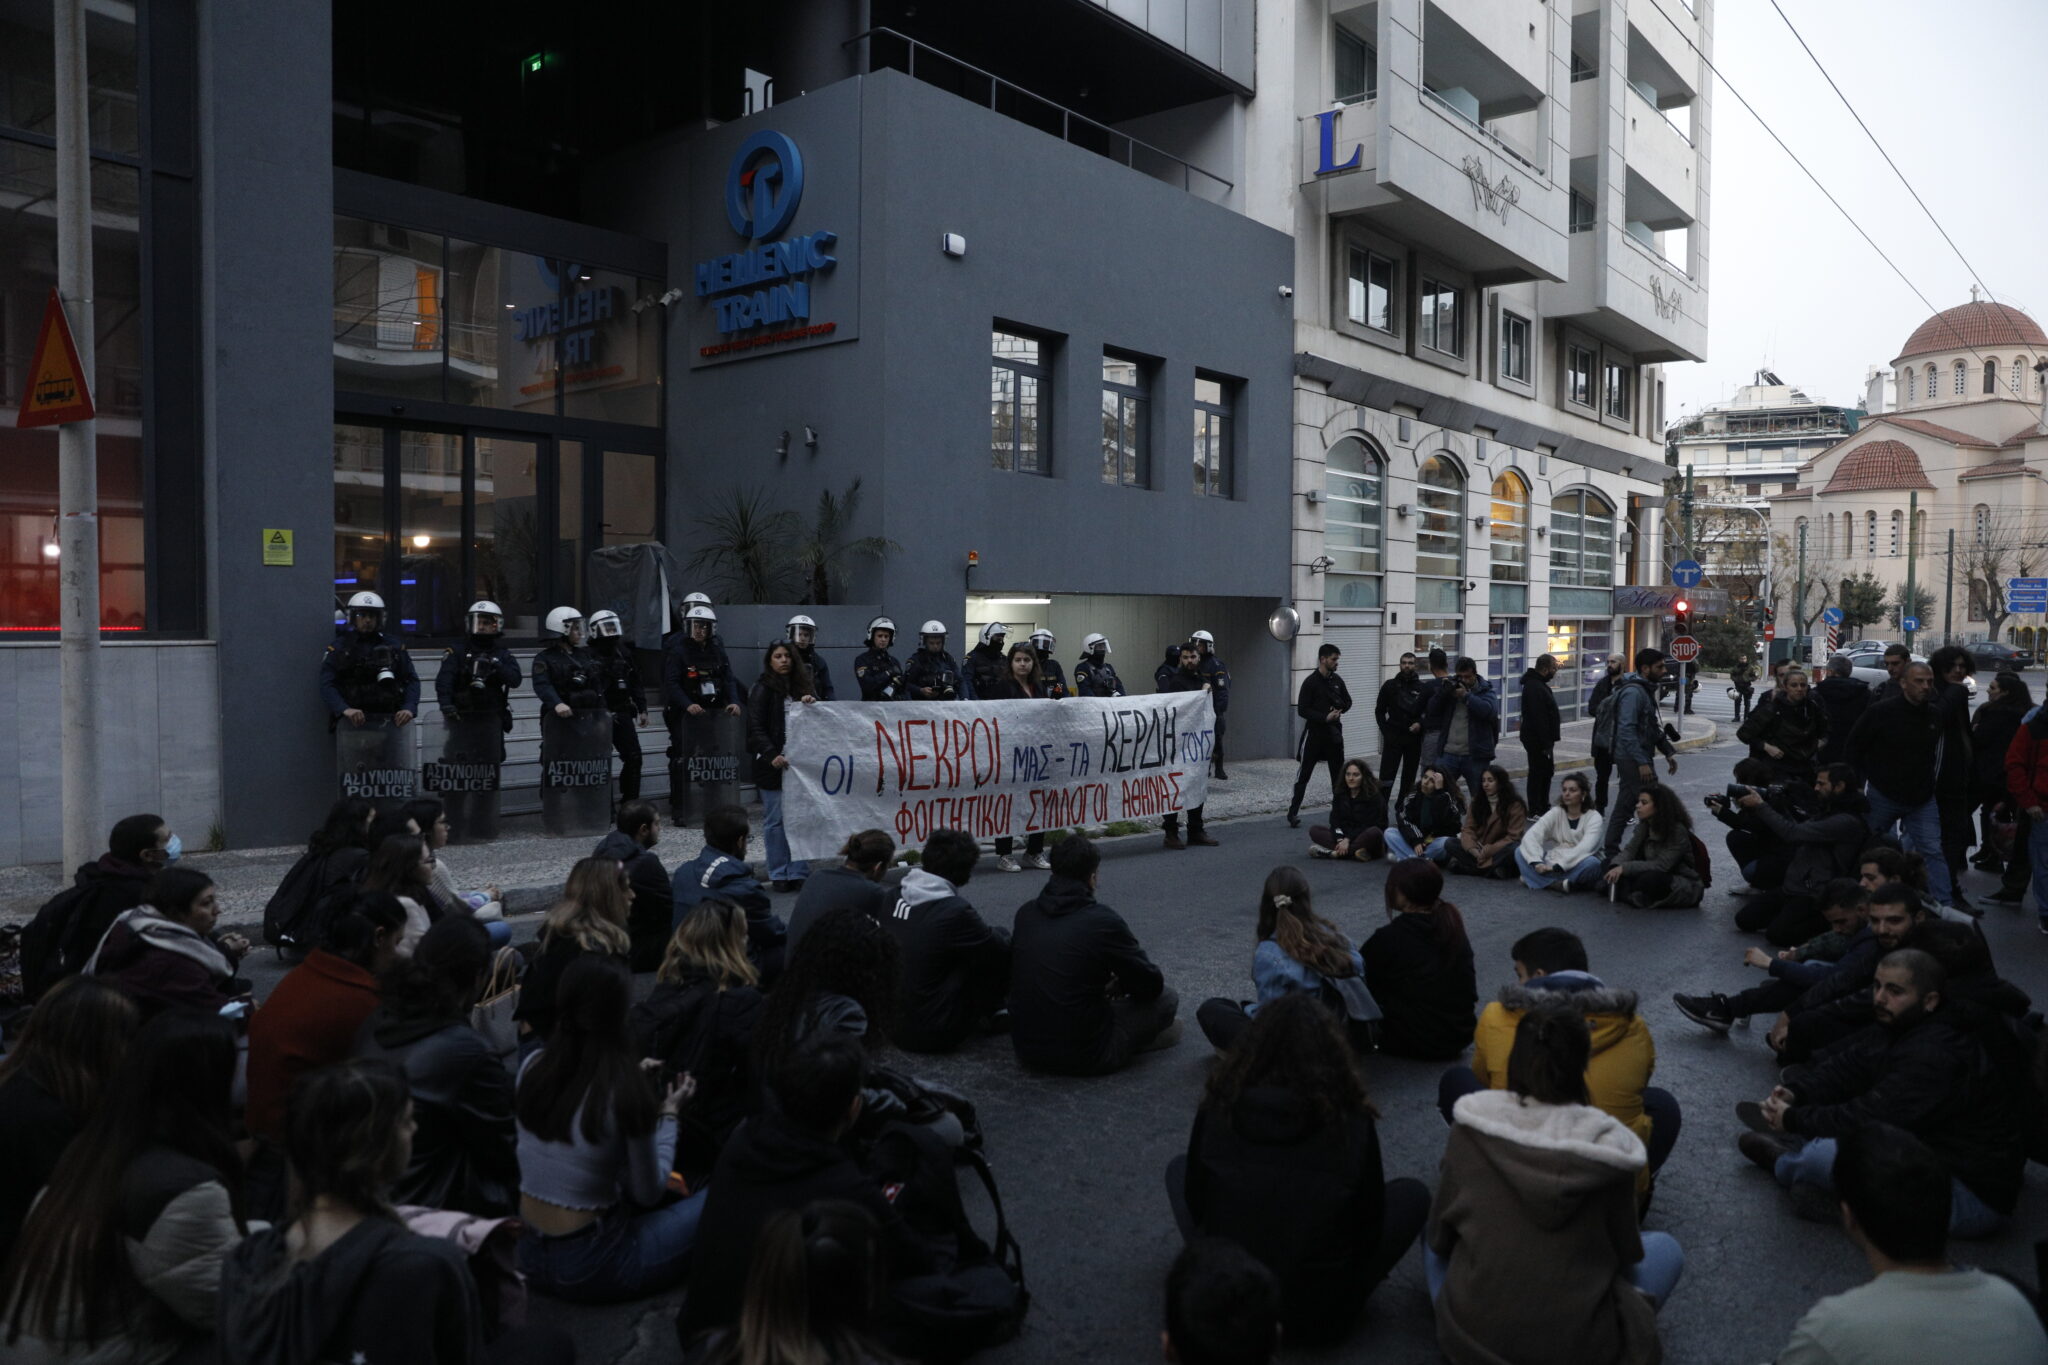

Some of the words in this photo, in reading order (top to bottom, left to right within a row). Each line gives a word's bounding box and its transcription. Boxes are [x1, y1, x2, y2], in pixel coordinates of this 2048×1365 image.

[1313, 110, 1364, 176] L
[695, 230, 838, 296] HELLENIC
[712, 280, 810, 334] TRAIN
[1618, 589, 1679, 609] Hotel
[1672, 643, 1697, 657] STOP
[821, 755, 854, 795] ΟΙ
[875, 717, 1001, 794] ΝΕΚΡΟΙ
[1100, 707, 1176, 774] ΚΕΡΔΗ
[1181, 730, 1213, 764] ΤΟΥΣ
[426, 763, 496, 779] ΑΣΤΥΝΟΜΙΑ
[547, 759, 609, 775] ΑΣΤΥΝΟΜΙΑ
[690, 769, 737, 781] POLICE
[343, 768, 416, 787] ΑΣΤΥΝΟΜΙΑ
[428, 778, 494, 792] POLICE
[550, 773, 607, 787] POLICE
[346, 785, 413, 798] POLICE
[895, 793, 1013, 845] ΦΟΙΤΗΤΙΚΟΙ
[1026, 783, 1109, 832] ΣΥΛΛΟΓΟΙ
[1122, 772, 1184, 818] ΑΘΗΝΑΣ
